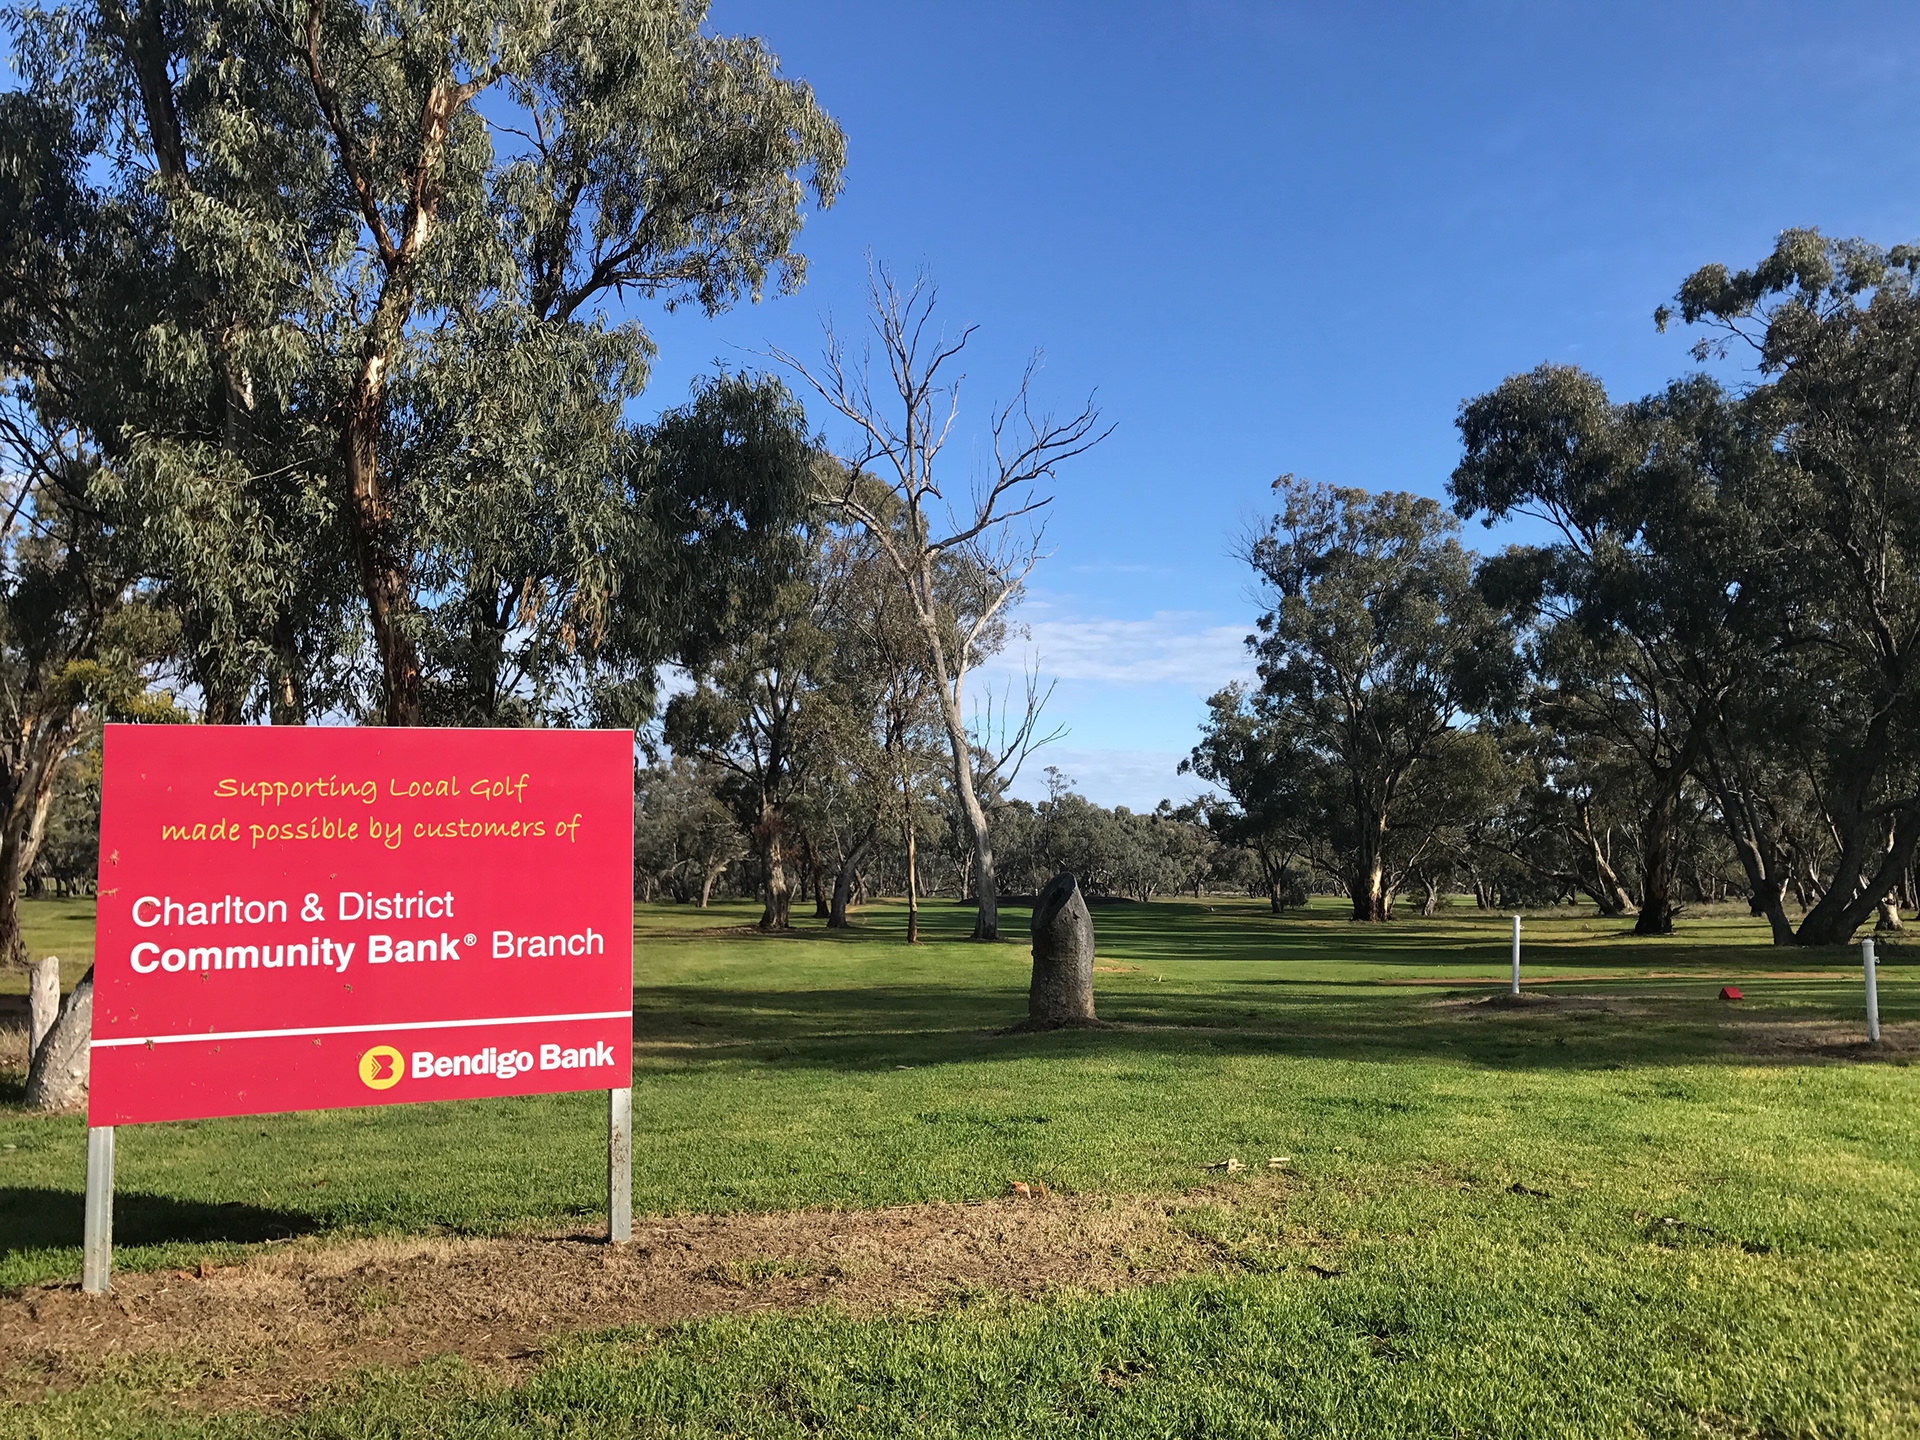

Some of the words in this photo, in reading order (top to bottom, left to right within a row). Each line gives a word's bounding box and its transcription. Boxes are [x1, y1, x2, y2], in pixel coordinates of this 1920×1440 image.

[213, 774, 377, 807] Supporting
[389, 775, 461, 798] Local
[470, 773, 530, 804] Golf
[162, 817, 241, 842] made
[249, 816, 359, 849] possible
[369, 815, 402, 850] by
[413, 818, 546, 838] customers
[555, 813, 583, 844] of
[131, 895, 288, 928] Charlton
[300, 892, 326, 923] &
[338, 890, 455, 921] District
[130, 936, 356, 974] Community
[492, 927, 604, 959] Branch
[411, 1047, 534, 1080] Bendigo
[539, 1040, 616, 1071] Bank
